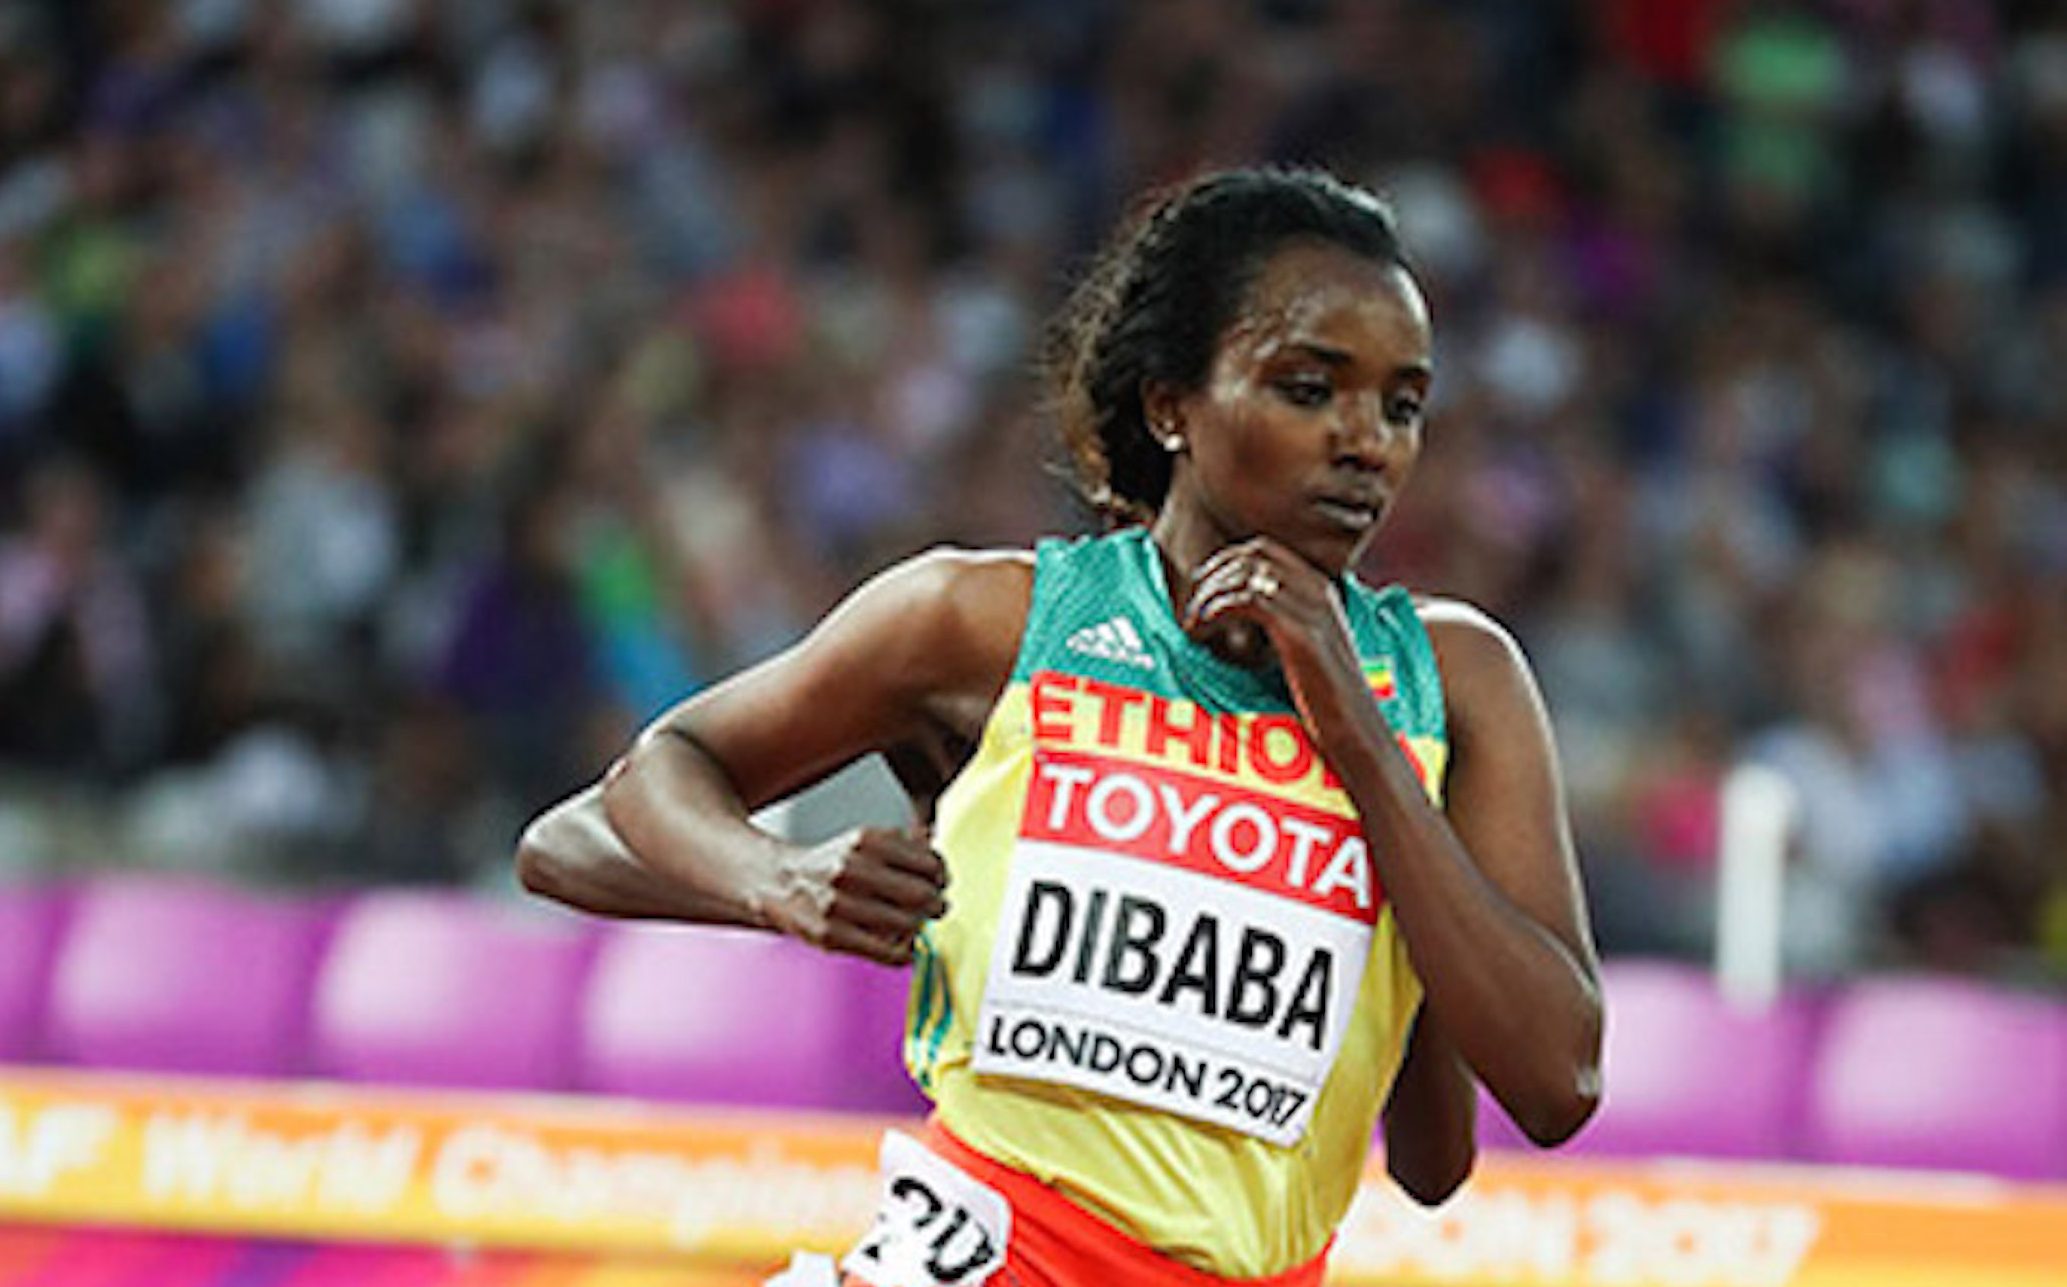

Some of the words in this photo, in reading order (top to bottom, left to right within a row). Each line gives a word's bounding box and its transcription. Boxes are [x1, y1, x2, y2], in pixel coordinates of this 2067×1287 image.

[1031, 669, 1427, 788] ETHIO
[1040, 763, 1372, 910] TOYOTA
[1010, 879, 1334, 1053] DIBABA
[988, 1015, 1208, 1099] LONDON
[1216, 1067, 1307, 1128] 2017
